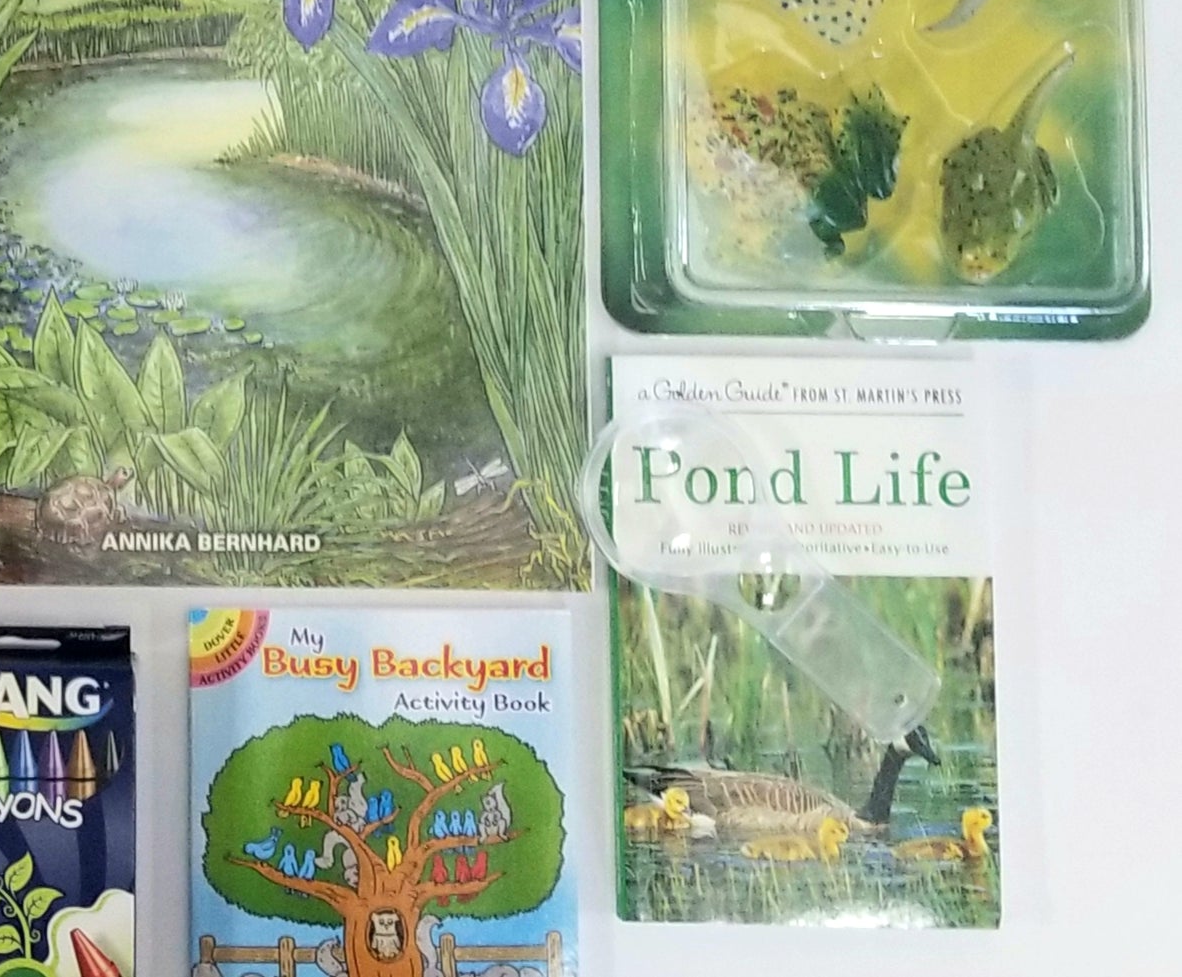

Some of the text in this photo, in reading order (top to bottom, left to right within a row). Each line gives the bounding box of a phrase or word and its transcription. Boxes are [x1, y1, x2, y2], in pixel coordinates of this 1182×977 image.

[637, 387, 649, 401] a
[652, 378, 722, 402] Golden
[792, 387, 828, 404] FROM
[856, 388, 918, 405] MARTIN'S
[924, 389, 963, 405] PRESS
[632, 445, 808, 506] Pond
[834, 450, 972, 507] Life
[101, 531, 322, 553] ANNIKA BERNHARD
[203, 617, 235, 652] DOVER
[214, 631, 245, 664] LITTLE
[290, 627, 324, 653] My
[199, 654, 248, 686] ACTIVITY
[261, 643, 552, 692] Busy Backyard
[394, 691, 552, 717] Activity Book
